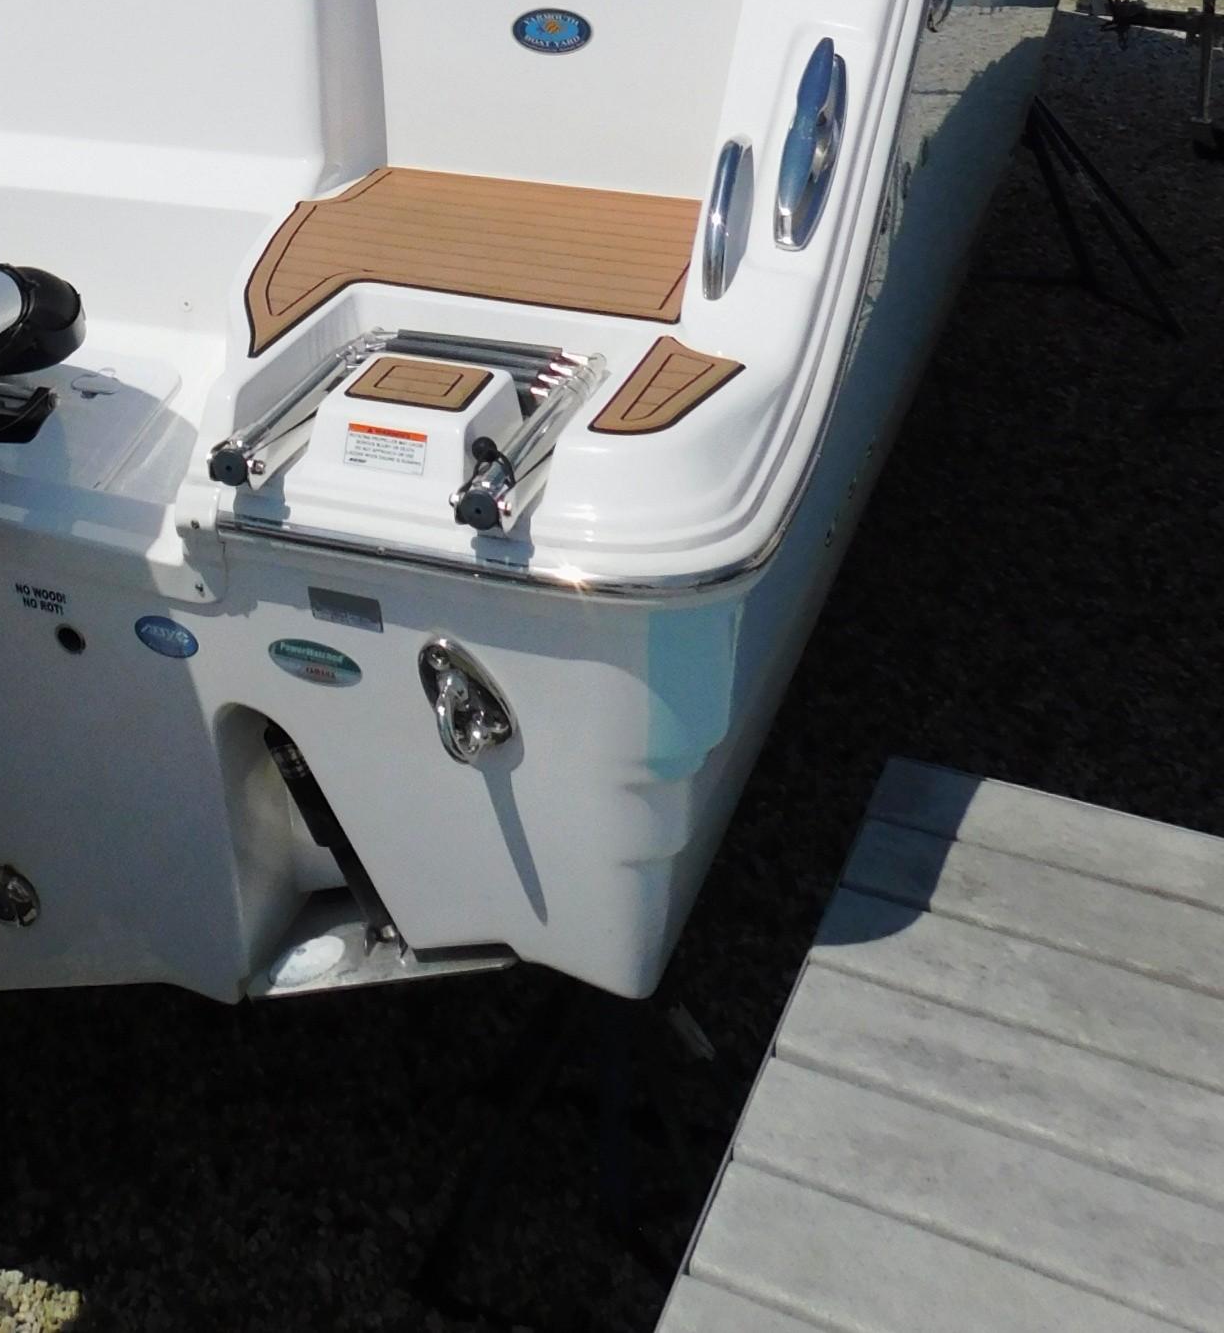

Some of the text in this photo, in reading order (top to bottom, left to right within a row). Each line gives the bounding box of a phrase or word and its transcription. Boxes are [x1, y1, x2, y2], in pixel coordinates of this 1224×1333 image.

[524, 13, 579, 25] YARMOUTH
[524, 34, 550, 47] BOAT
[554, 35, 580, 48] YARD
[15, 582, 31, 595] NO
[22, 596, 38, 609] NO
